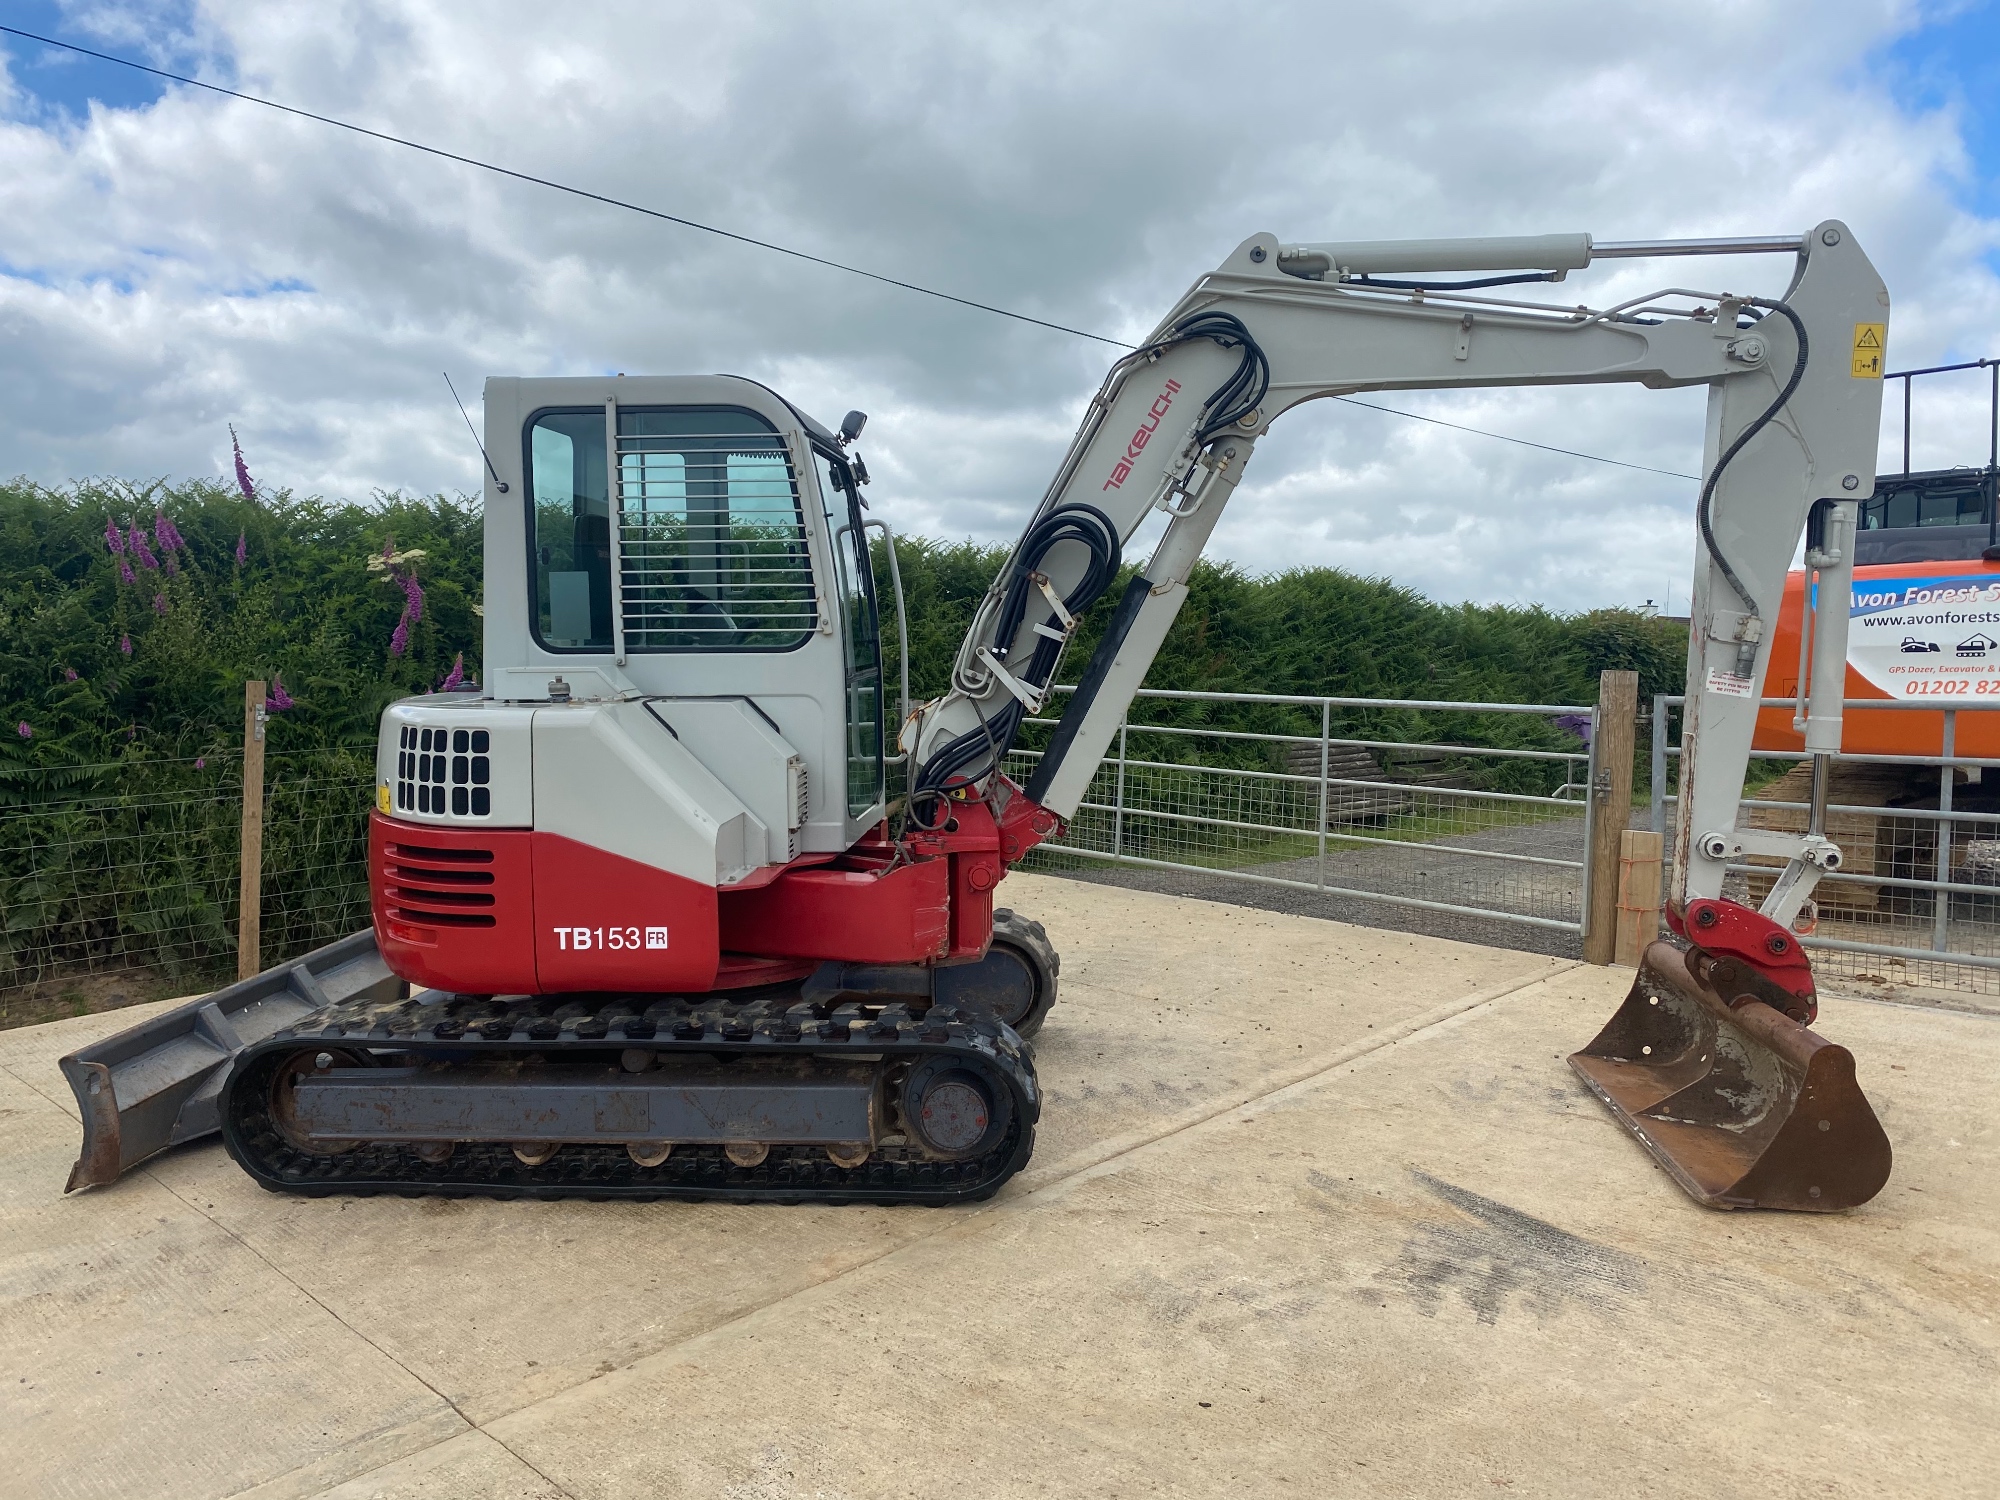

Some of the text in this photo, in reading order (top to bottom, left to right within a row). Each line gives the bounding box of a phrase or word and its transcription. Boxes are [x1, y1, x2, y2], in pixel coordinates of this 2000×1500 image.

[1904, 585, 1979, 605] Forest
[1888, 666, 1906, 674] GPS
[1908, 666, 1936, 674] Dozer,
[1939, 665, 1985, 674] Excavator
[1906, 680, 1969, 695] 01202
[553, 927, 666, 950] TB153 FR
